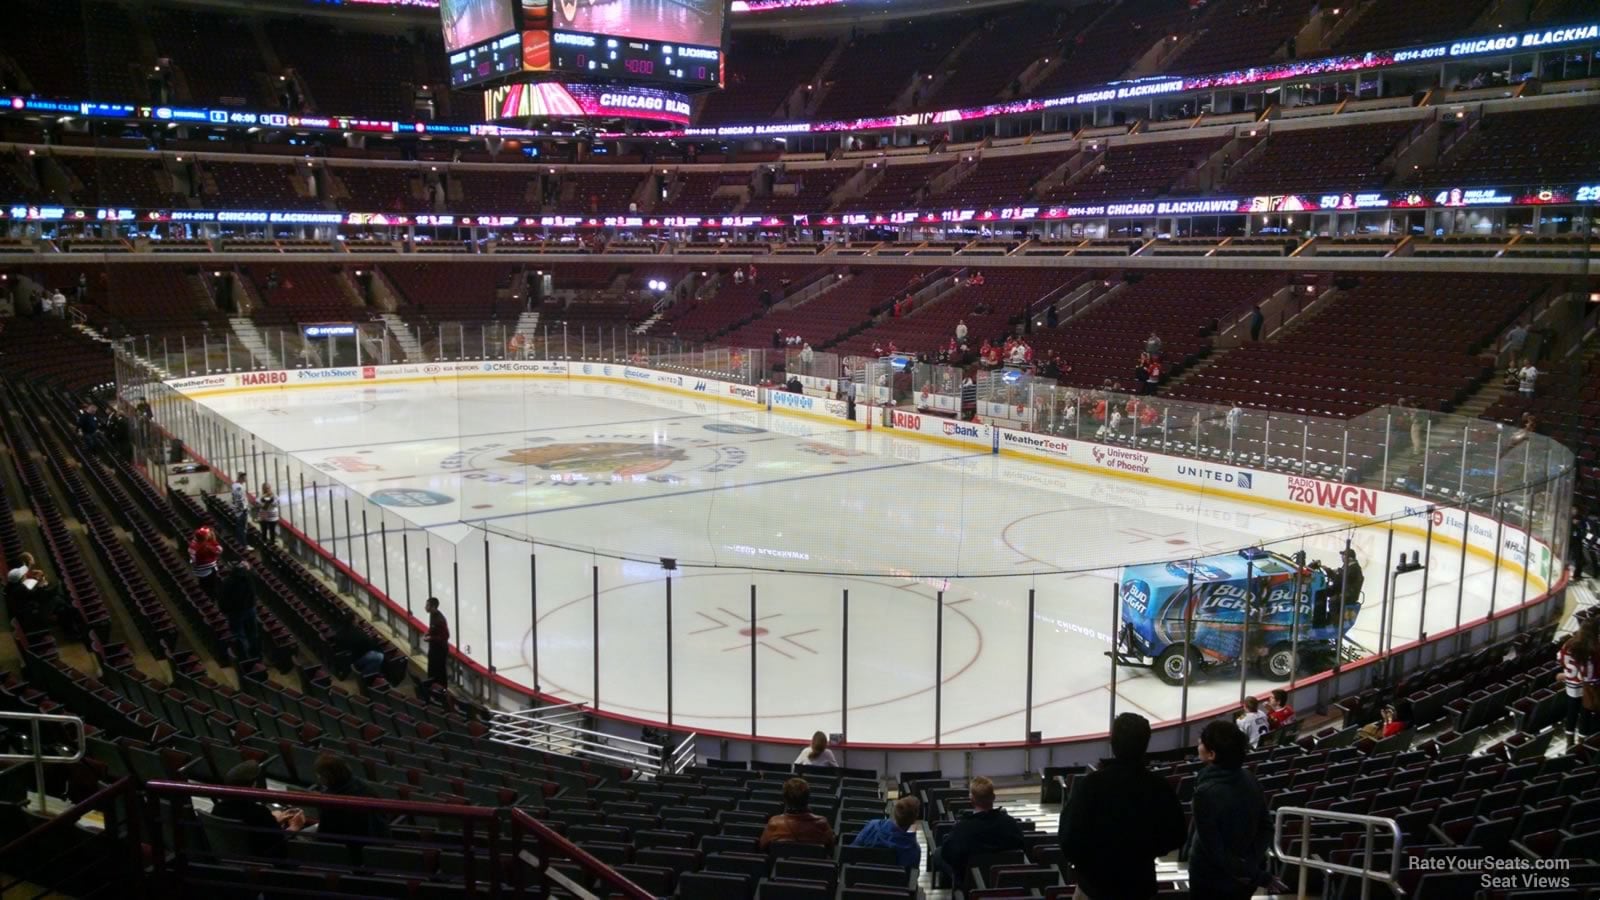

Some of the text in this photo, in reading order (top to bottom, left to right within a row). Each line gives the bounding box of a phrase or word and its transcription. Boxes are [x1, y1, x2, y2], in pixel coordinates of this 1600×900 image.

[1394, 26, 1600, 62] 2014-2015 CHICAGO BLACKHA
[1077, 89, 1116, 104] CHICAGO
[1118, 81, 1183, 98] BLACKHAWKS
[600, 94, 663, 110] CHICAGO
[718, 126, 754, 135] CHICAGO
[755, 123, 811, 134] BLACKHAWKS
[1320, 195, 1340, 208] 50
[1435, 191, 1449, 204] 4
[1068, 200, 1239, 216] 2014-2015 CHICAGO BLACKHAWKS
[171, 212, 342, 223] 2014-2015 CHICAGO BLACKHAWKS
[304, 368, 358, 379] NorthShore
[493, 363, 511, 371] CME
[513, 363, 539, 373] Group
[173, 377, 225, 389] WeatherTech
[242, 371, 288, 386] HARIBO
[892, 412, 921, 431] ARIBO
[1003, 432, 1068, 452] WeatherTech
[1107, 448, 1149, 465] University
[1106, 459, 1150, 474] of Phoenix
[1177, 465, 1234, 483] UNITED
[1288, 477, 1315, 489] RADIO
[1288, 481, 1378, 516] 720 WGN
[1473, 525, 1494, 540] Bank
[1129, 584, 1147, 604] BUD
[1213, 584, 1256, 603] BUD
[1124, 591, 1147, 614] LIGHT
